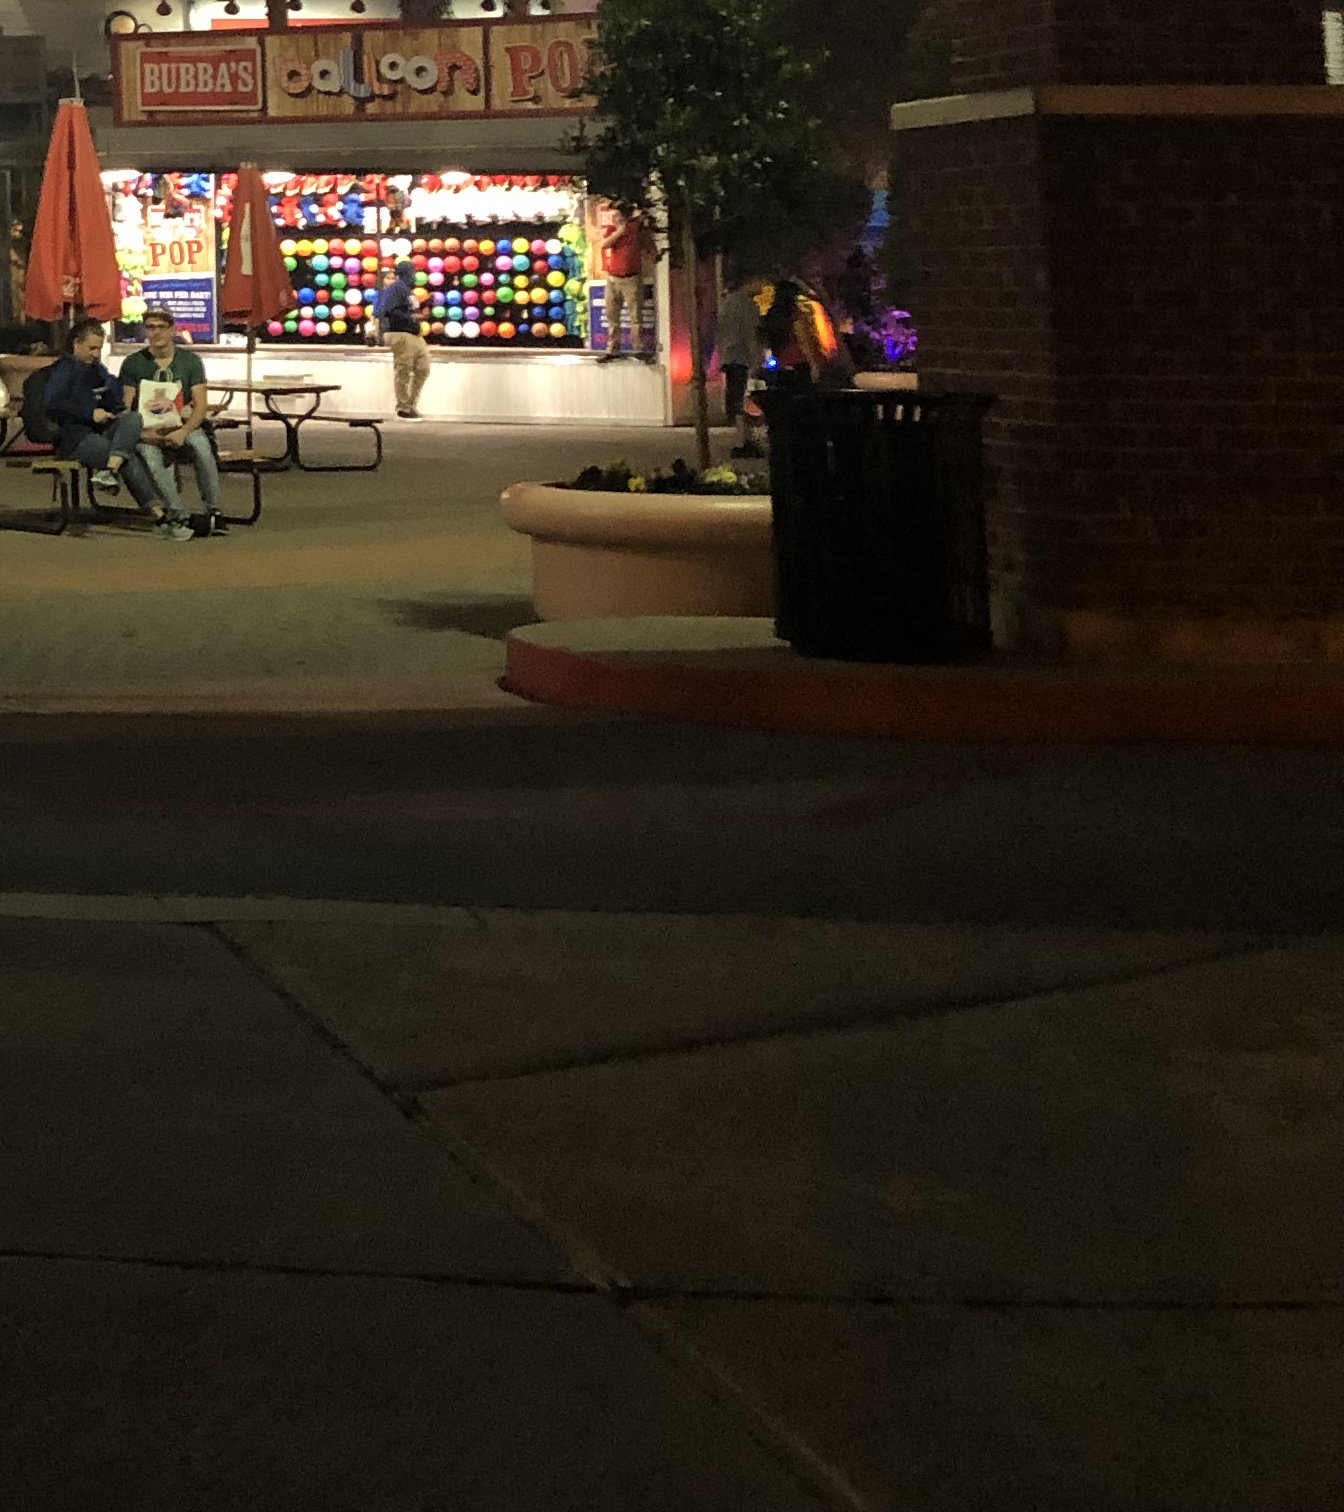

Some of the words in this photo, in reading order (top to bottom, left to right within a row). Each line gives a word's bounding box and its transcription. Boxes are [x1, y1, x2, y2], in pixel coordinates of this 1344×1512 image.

[143, 61, 255, 95] BUBBA'S
[503, 39, 587, 103] PO
[149, 240, 204, 268] POP
